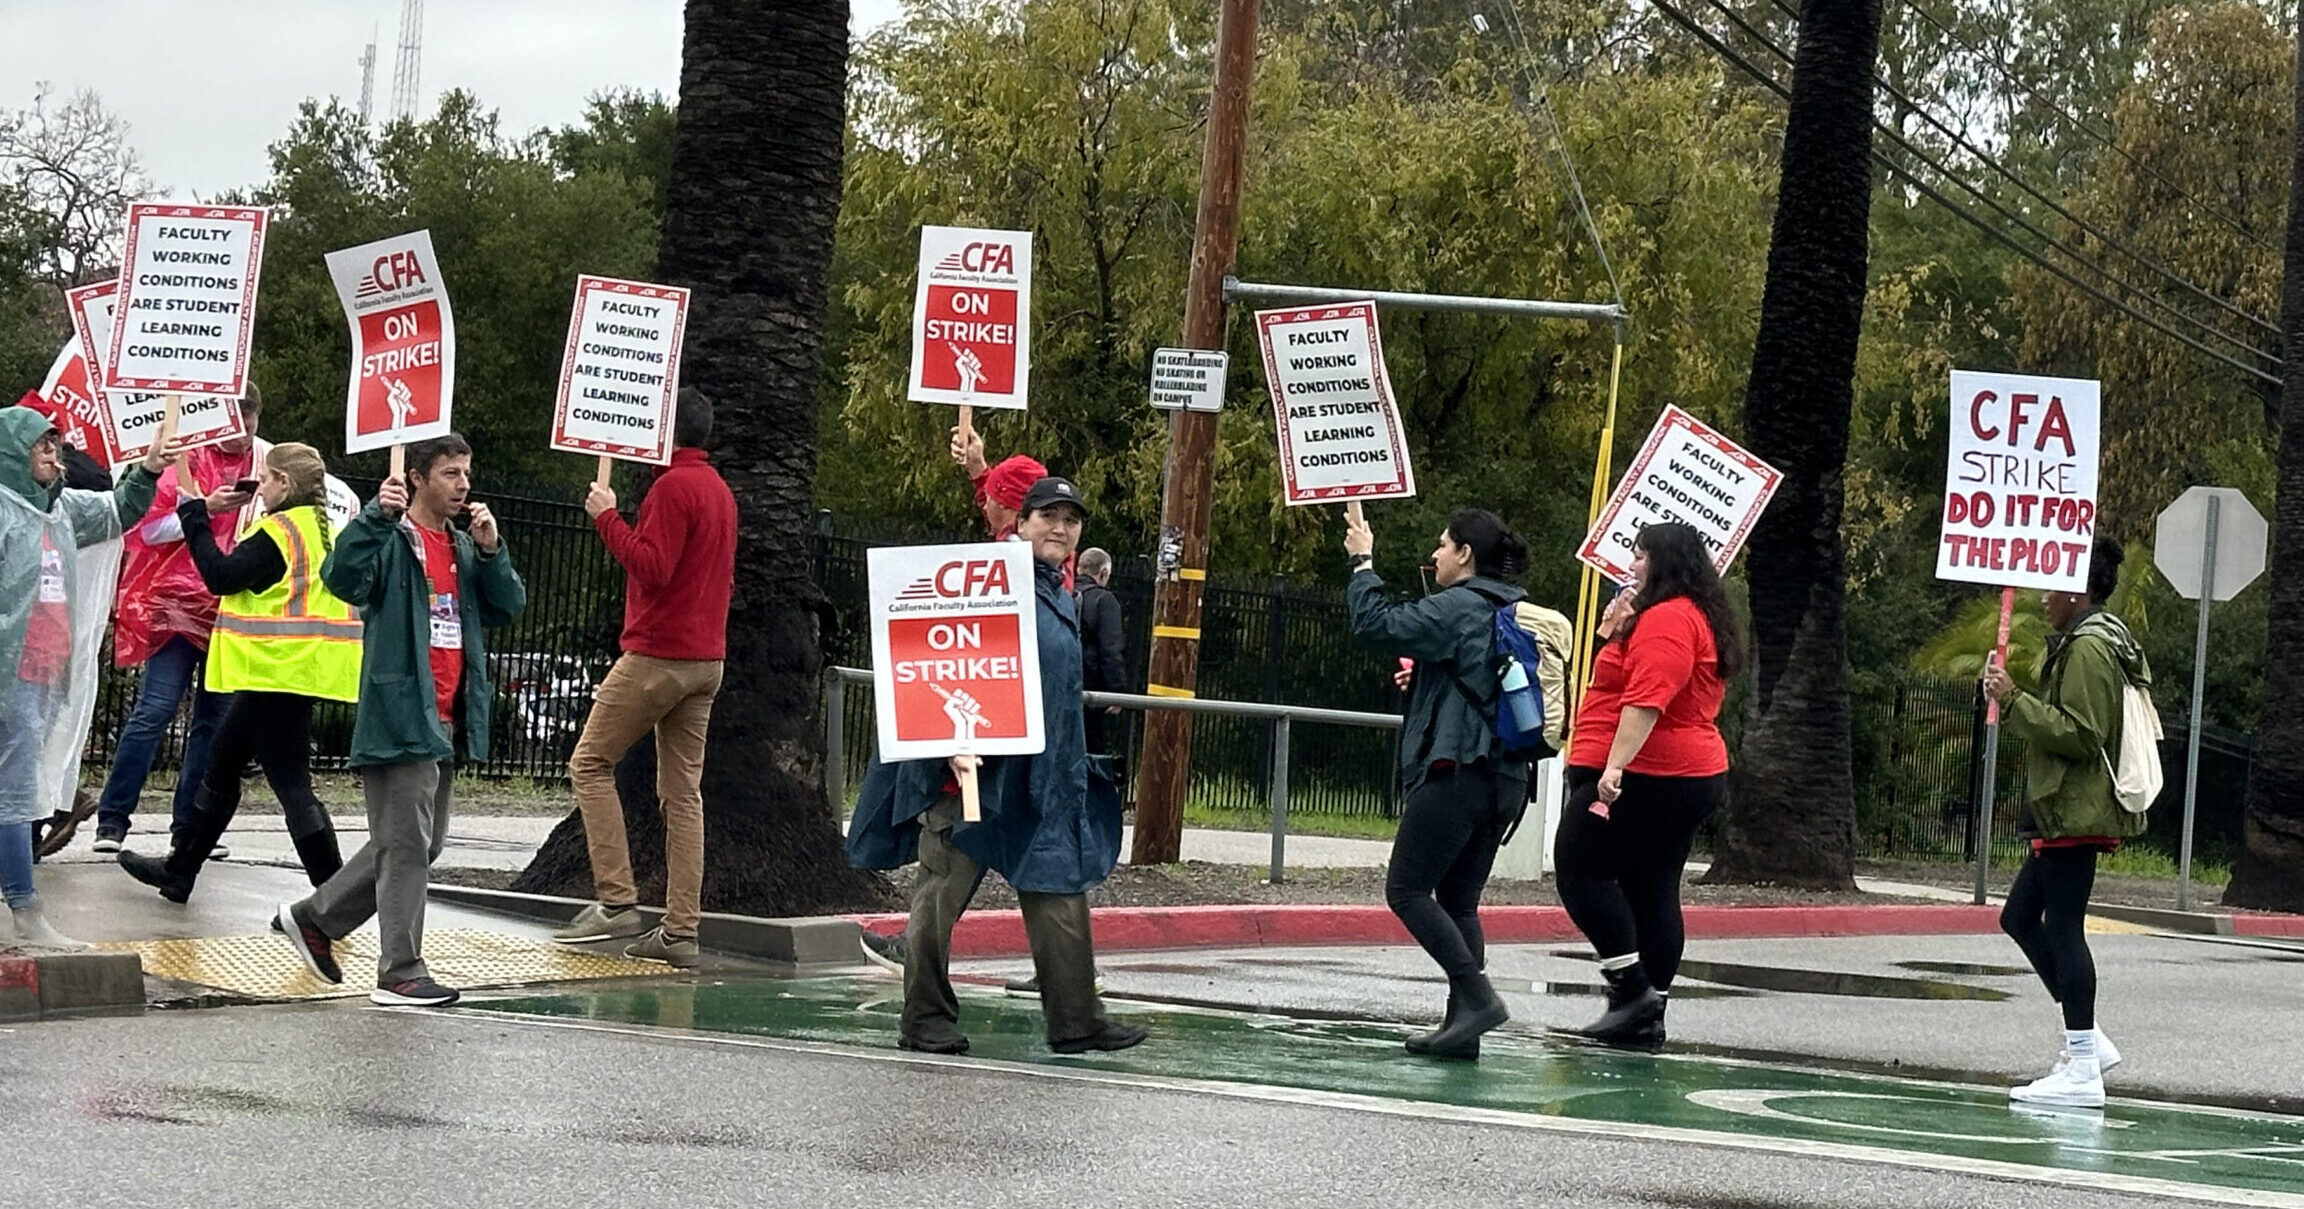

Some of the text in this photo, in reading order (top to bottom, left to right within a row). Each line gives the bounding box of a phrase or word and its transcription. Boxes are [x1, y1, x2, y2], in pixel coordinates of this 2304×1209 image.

[158, 227, 232, 241] FACULTY
[152, 252, 231, 265] WORKING
[962, 242, 1013, 274] CFA
[373, 250, 426, 292] CFA
[930, 272, 957, 280] California
[139, 275, 237, 290] CONDITIONS
[131, 299, 240, 314] ARE STUDENT
[601, 301, 660, 318] FACULTY
[952, 292, 989, 315] ON
[141, 322, 221, 337] LEARNING
[384, 311, 418, 341] ON
[596, 322, 659, 340] WORKING
[927, 320, 1013, 344] STRIKE!
[1289, 329, 1349, 345] FACULTY
[128, 345, 228, 362] CONDITIONS
[363, 341, 439, 378] STRIKE!
[583, 343, 663, 363] CONDITIONS
[1158, 356, 1166, 364] NO
[1290, 355, 1356, 370] WORKING
[575, 364, 664, 386] ARE STUDENT
[1157, 368, 1164, 376] NO
[1197, 370, 1205, 379] OR
[1288, 378, 1369, 394] CONDITIONS
[52, 384, 99, 427] STRI
[583, 388, 649, 407] LEARNING
[1154, 393, 1162, 401] ON
[122, 398, 219, 429] CONDIONS
[573, 408, 654, 429] CONDITIONS
[1290, 401, 1380, 419] ARE STUDENT
[1970, 390, 2076, 457] CFA
[1305, 426, 1375, 442] LEARNING
[1300, 450, 1388, 467] CONDITIONS
[1682, 442, 1745, 485] FACULTY
[1959, 451, 2077, 494] STRIKE
[1668, 459, 1735, 507] WORKING
[1630, 491, 1661, 514] ARE
[1648, 474, 1732, 531] CONDITIONS
[1947, 491, 2094, 536] DO IT FOR
[1944, 534, 2087, 577] THE PLOT
[935, 559, 1010, 598] CFA
[889, 599, 1017, 613] California Faculty Association
[927, 623, 981, 650] ON
[896, 657, 1019, 683] STRIKE!
